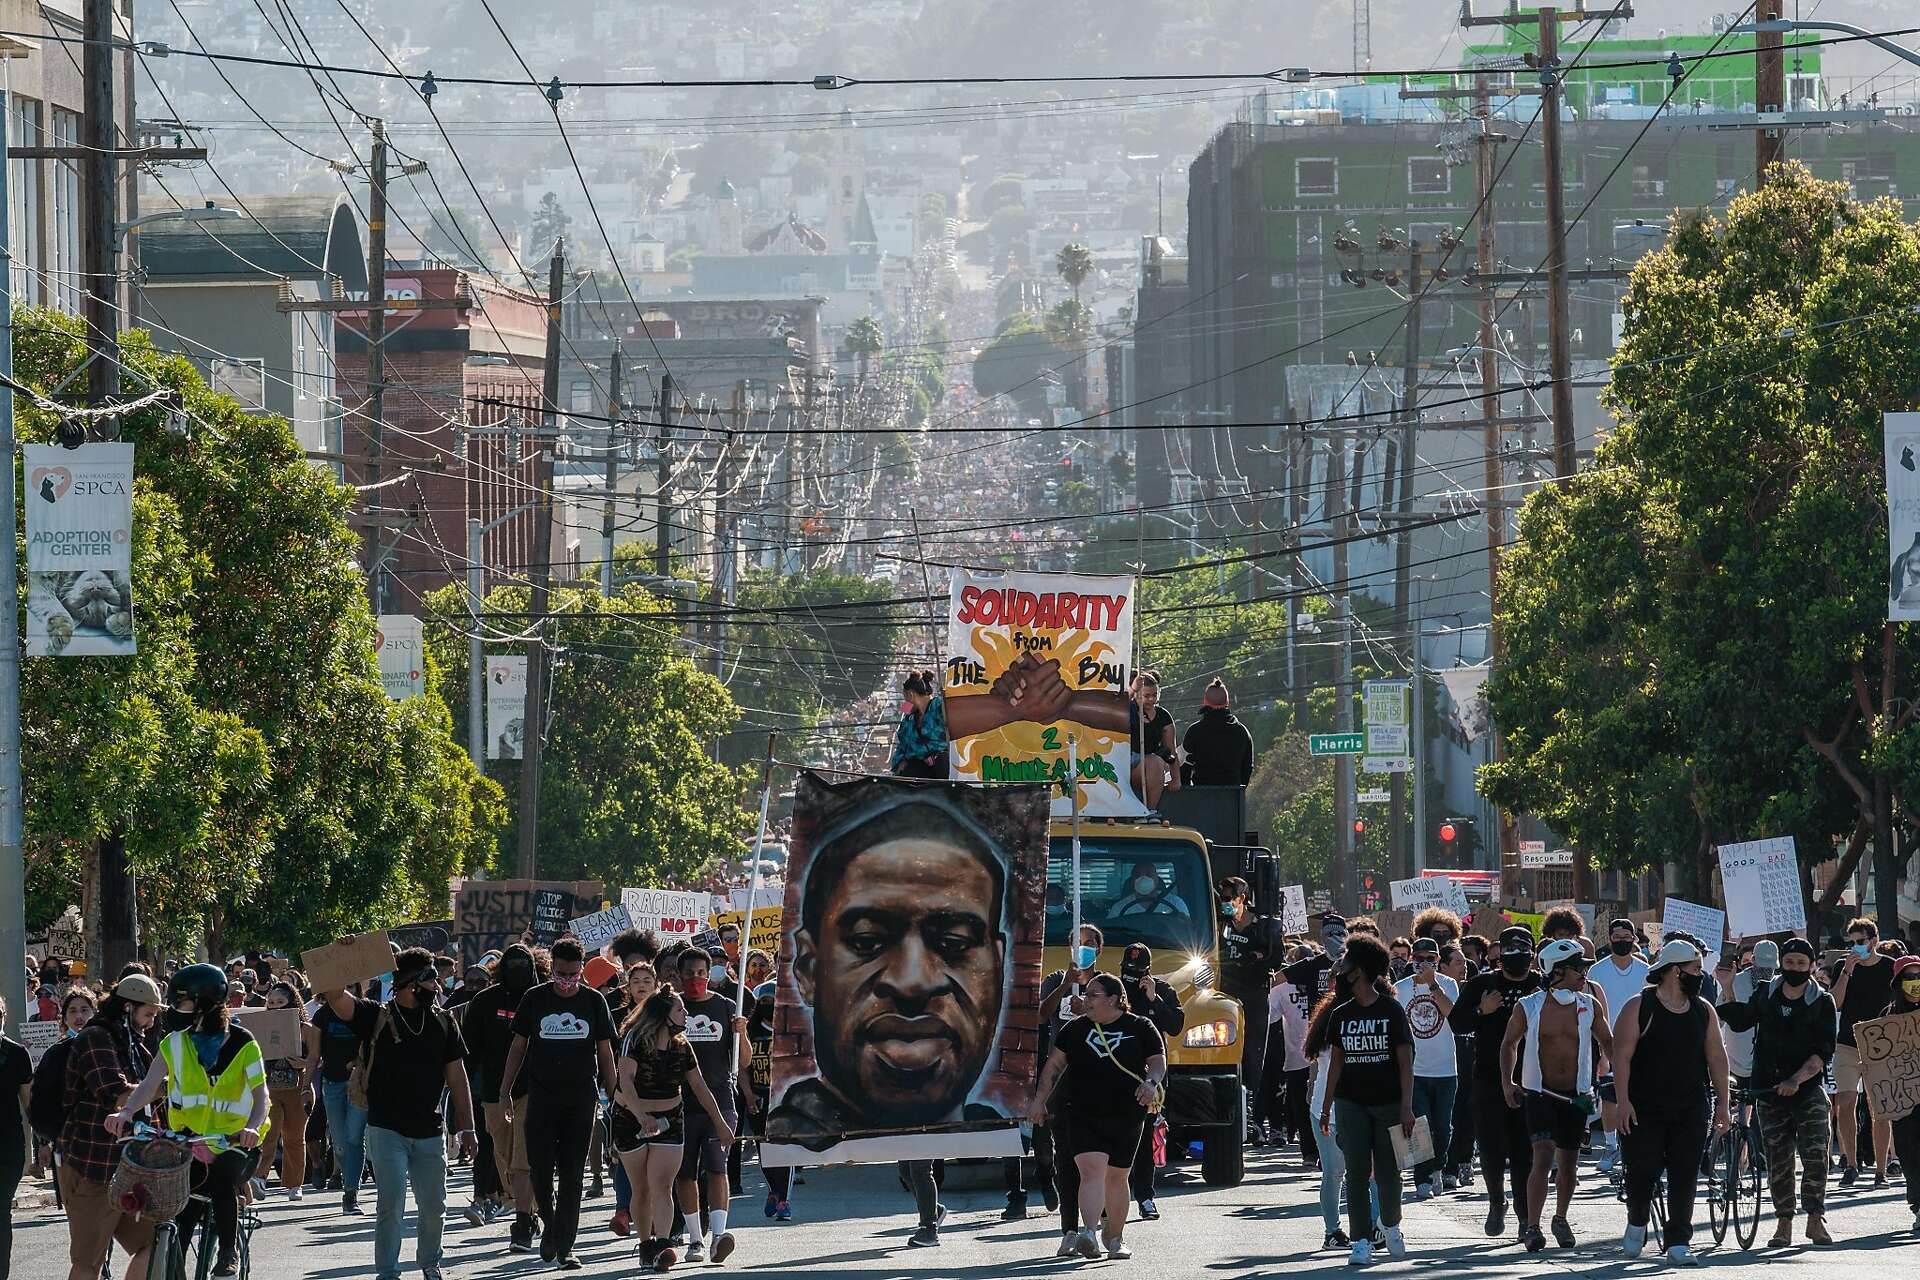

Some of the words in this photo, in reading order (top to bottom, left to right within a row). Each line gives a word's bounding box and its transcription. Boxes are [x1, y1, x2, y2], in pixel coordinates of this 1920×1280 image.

[74, 481, 125, 495] SPCA
[32, 530, 111, 543] ADOPTION
[50, 544, 111, 556] CENTER
[957, 586, 1127, 631] SOLIDARITY
[386, 640, 418, 650] SPCA
[948, 656, 989, 686] THE
[1041, 727, 1062, 750] 2
[1524, 855, 1554, 863] Rescue
[1726, 859, 1755, 868] GOOD
[1768, 854, 1786, 863] BAD
[540, 892, 562, 905] STOP
[627, 891, 696, 918] RACISM
[536, 907, 565, 918] POLICE
[661, 917, 698, 933] NOT
[53, 945, 85, 957] POLICE
[1346, 1019, 1389, 1034] CAN'T
[1341, 1034, 1389, 1051] BREATHE
